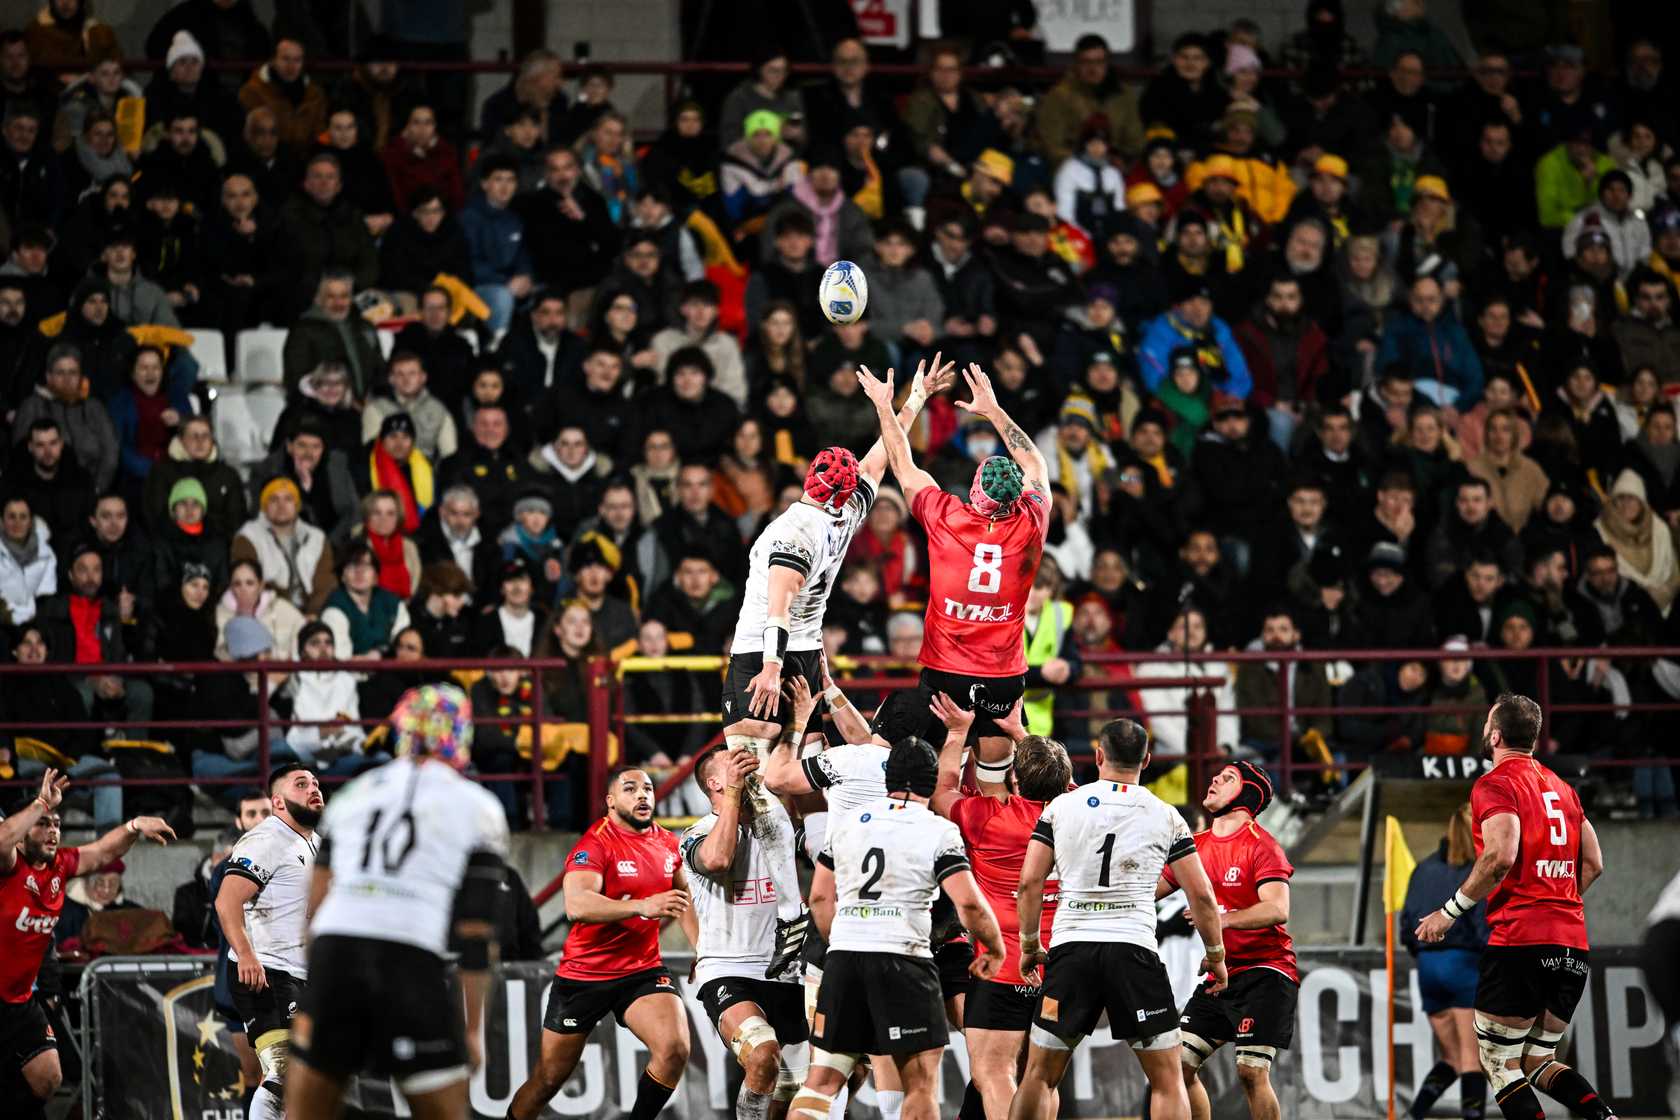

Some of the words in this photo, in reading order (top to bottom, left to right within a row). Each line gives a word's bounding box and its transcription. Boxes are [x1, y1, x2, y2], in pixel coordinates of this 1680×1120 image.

[967, 542, 1003, 594] 8
[944, 597, 991, 621] TVH
[360, 807, 417, 877] 10
[1541, 791, 1568, 846] 5
[858, 847, 886, 901] 2
[1096, 833, 1116, 888] 1
[872, 906, 903, 918] Bank
[1541, 956, 1562, 969] VAN
